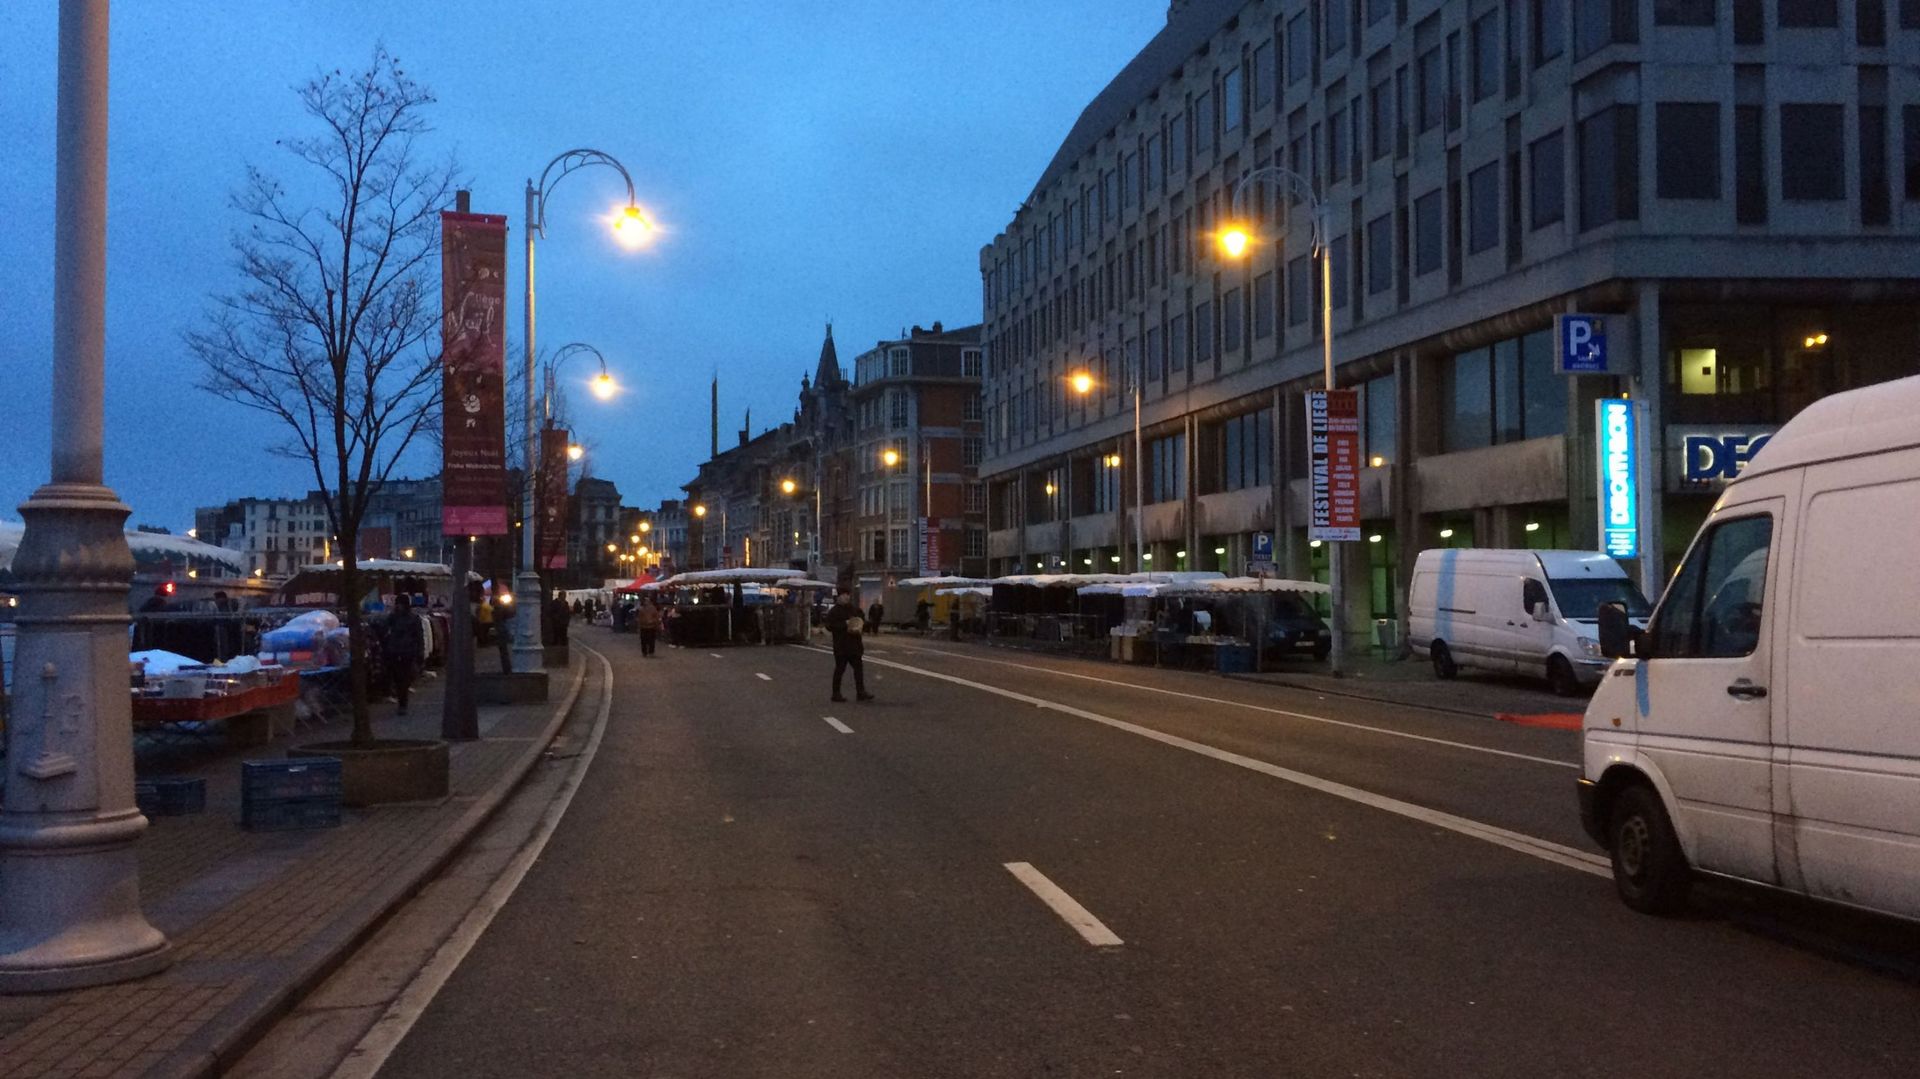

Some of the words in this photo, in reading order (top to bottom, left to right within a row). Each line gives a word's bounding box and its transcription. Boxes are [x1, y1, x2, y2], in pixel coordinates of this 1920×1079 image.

[1570, 320, 1591, 356] P
[1313, 435, 1328, 453] DE
[1608, 404, 1629, 524] DECATHLON
[1314, 458, 1329, 527] FESTIVAL
[1258, 535, 1268, 550] P
